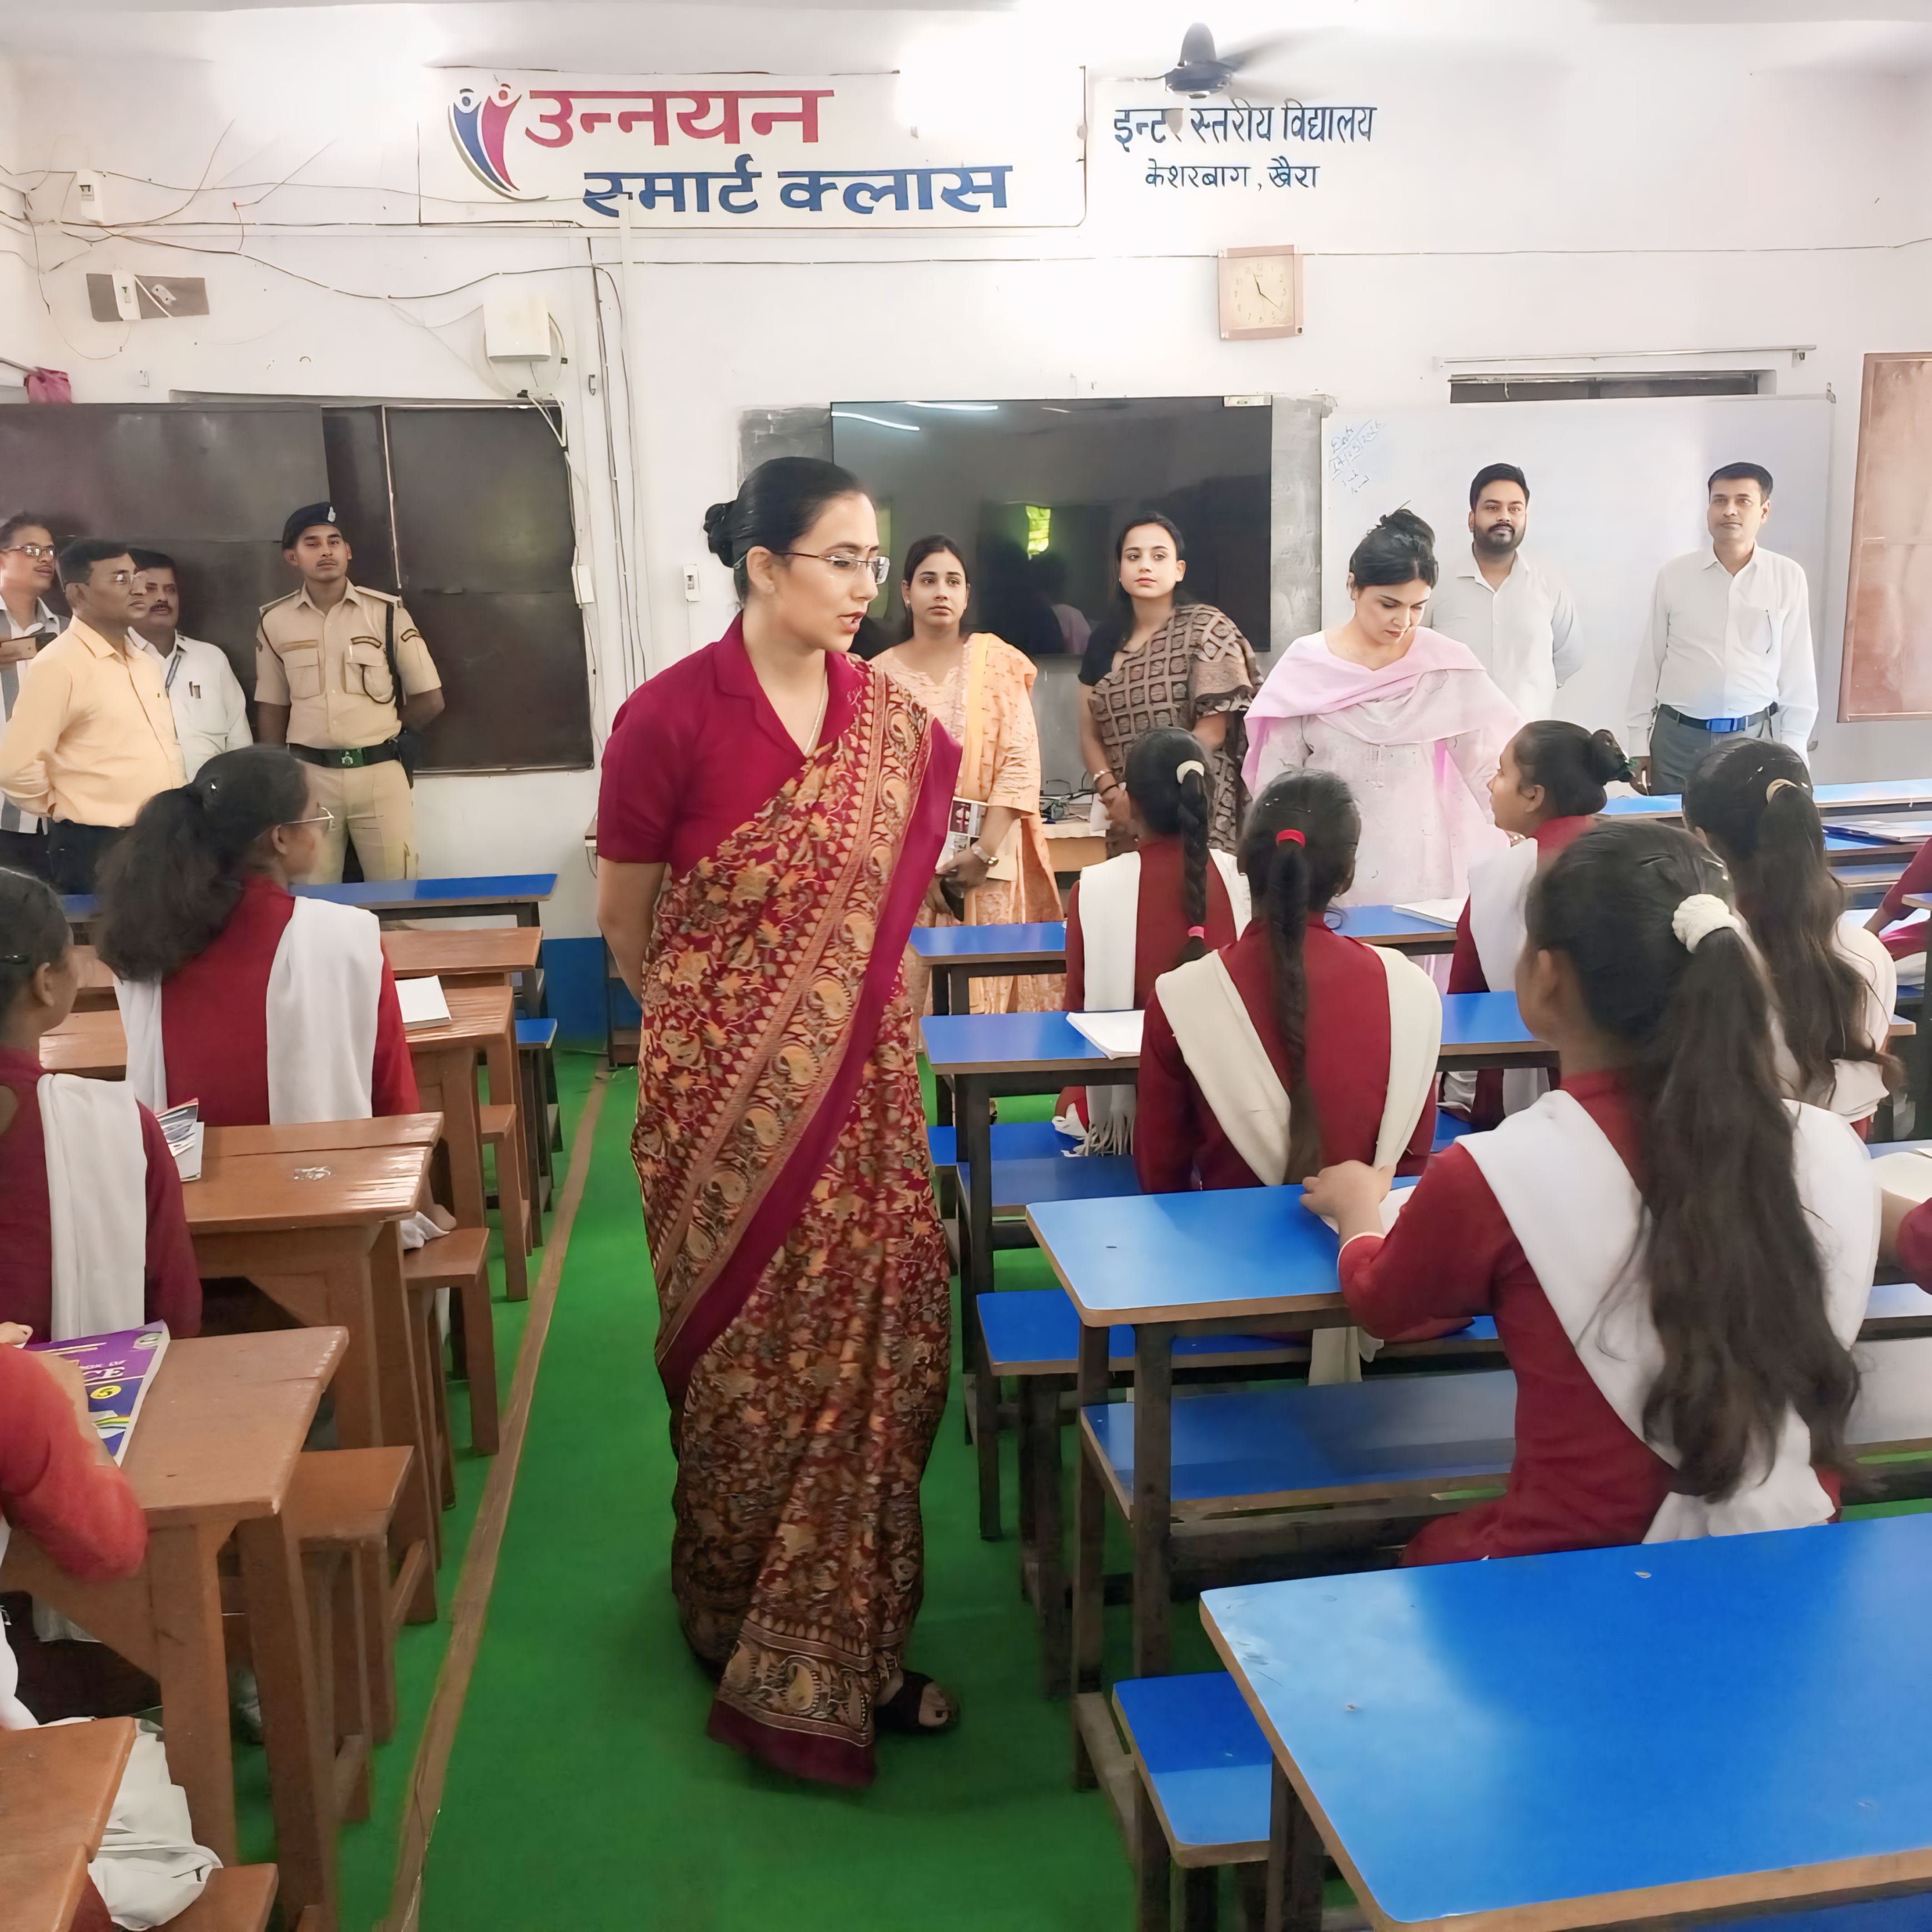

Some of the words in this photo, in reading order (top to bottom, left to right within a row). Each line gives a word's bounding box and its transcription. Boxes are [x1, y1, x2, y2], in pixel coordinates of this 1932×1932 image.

[525, 89, 834, 148] उन्नयन
[1114, 108, 1184, 153] इन्ट
[1190, 97, 1275, 144] स्तरीय
[1280, 97, 1378, 144] विद्यालय
[582, 153, 762, 218] स्मार्ट
[777, 165, 1014, 214] क्लास
[1266, 155, 1321, 189] खैरा
